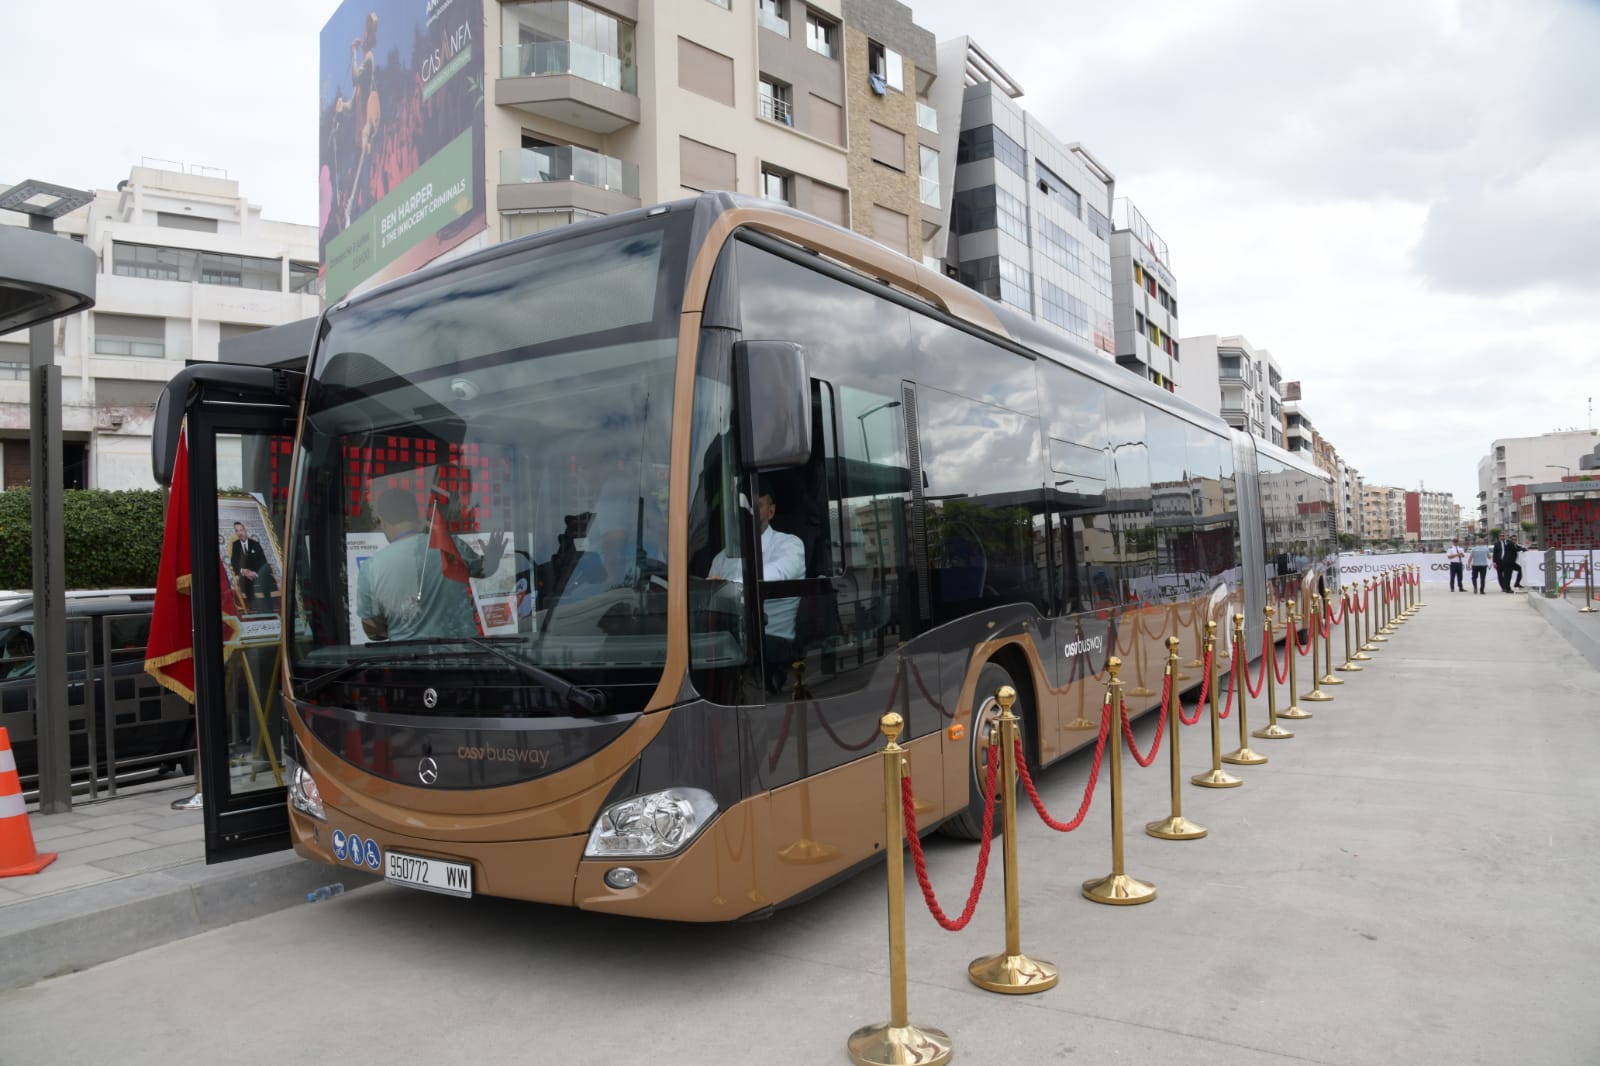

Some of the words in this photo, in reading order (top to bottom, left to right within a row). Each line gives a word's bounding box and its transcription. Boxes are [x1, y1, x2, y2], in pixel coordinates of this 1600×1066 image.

[422, 20, 471, 82] CASANFA
[381, 211, 397, 234] BEN
[398, 183, 433, 221] HARPER
[386, 228, 397, 244] THE
[398, 205, 429, 237] INNOCENT
[429, 178, 466, 213] CRIMINALS
[390, 855, 429, 883] 950772
[446, 866, 468, 889] WW
